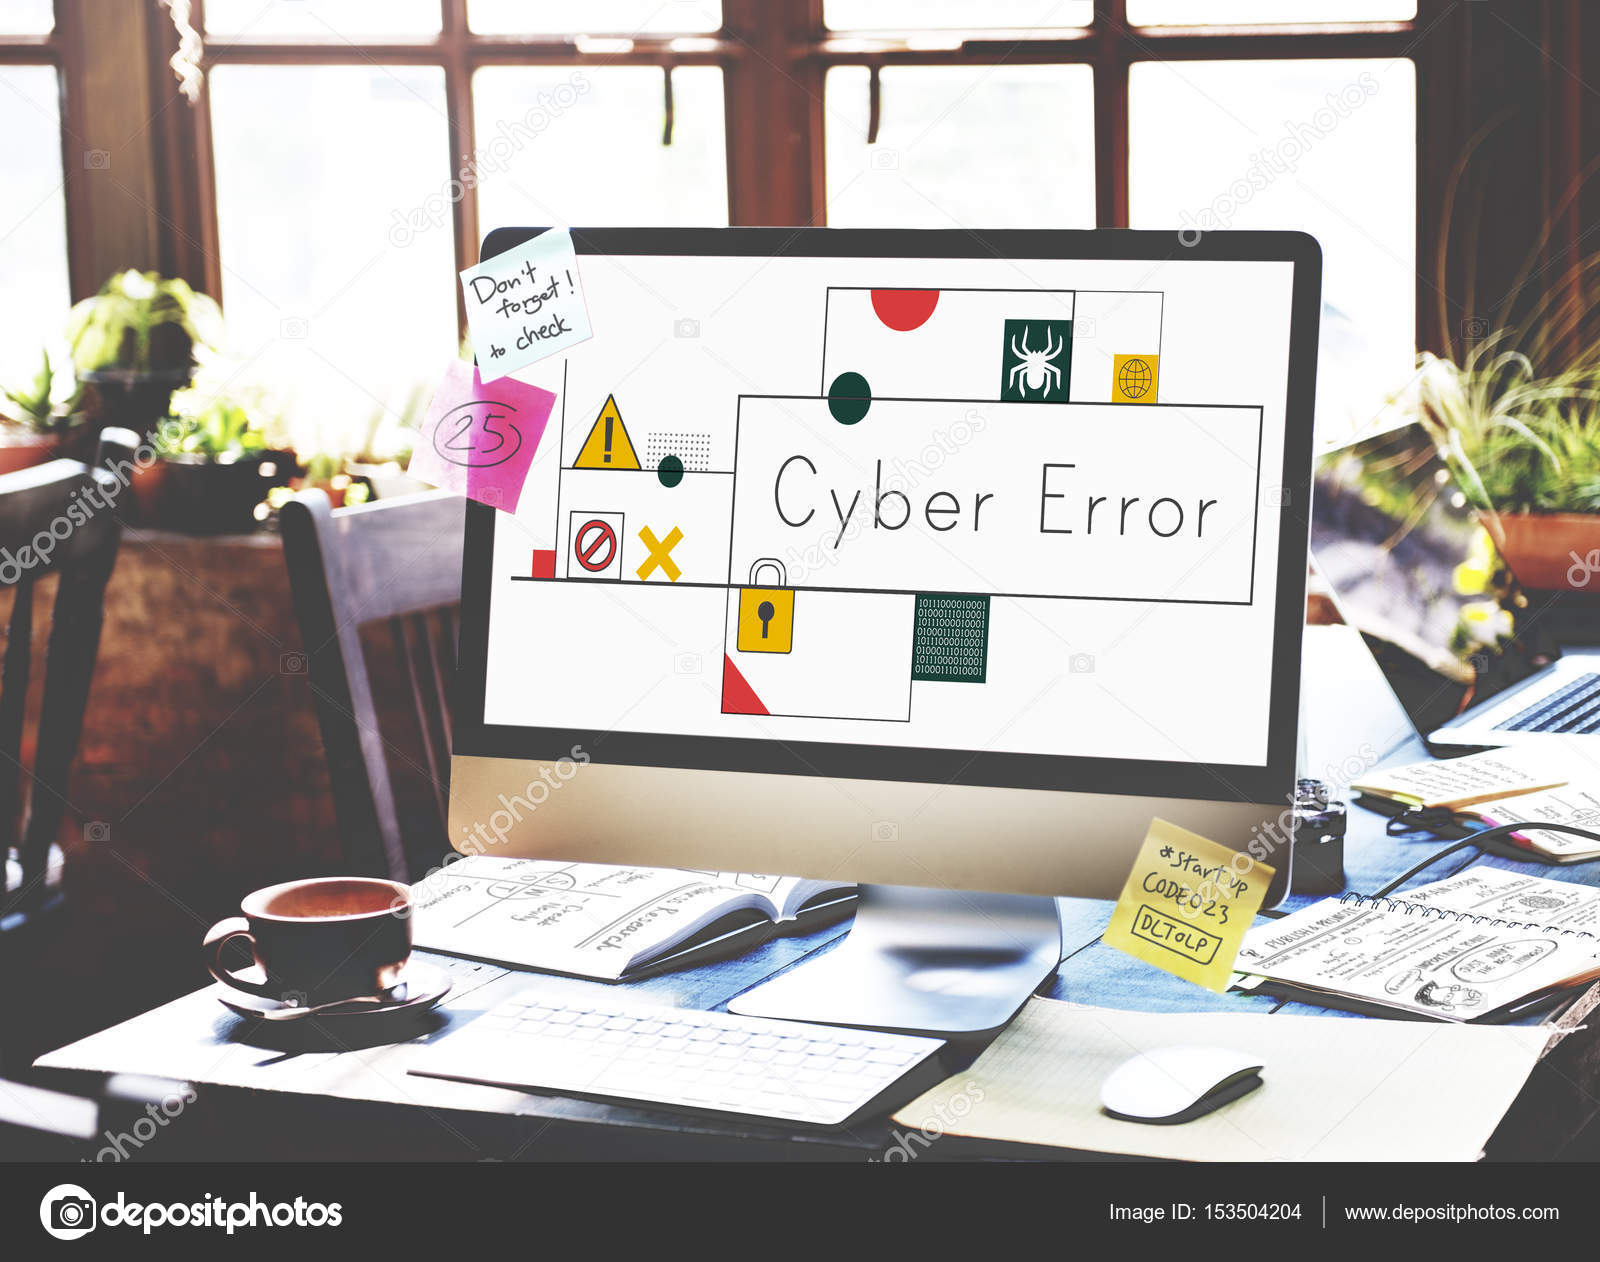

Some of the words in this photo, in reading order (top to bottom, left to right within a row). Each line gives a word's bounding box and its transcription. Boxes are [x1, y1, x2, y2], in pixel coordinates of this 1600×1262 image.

[469, 260, 537, 304] Don't
[490, 343, 506, 360] to
[515, 313, 572, 351] check
[443, 413, 506, 453] 25
[774, 455, 994, 549] Cyber
[1040, 463, 1217, 538] Error
[919, 599, 986, 610] 10111000010001
[918, 608, 985, 619] 01000111010001
[918, 618, 984, 629] 10111000010001
[917, 627, 984, 638] 01000111010001
[917, 636, 983, 647] 10111000010001
[916, 646, 983, 657] 01000111010001
[916, 655, 982, 666] 10111000010001
[915, 664, 982, 676] 01000111010001
[596, 906, 679, 950] Research
